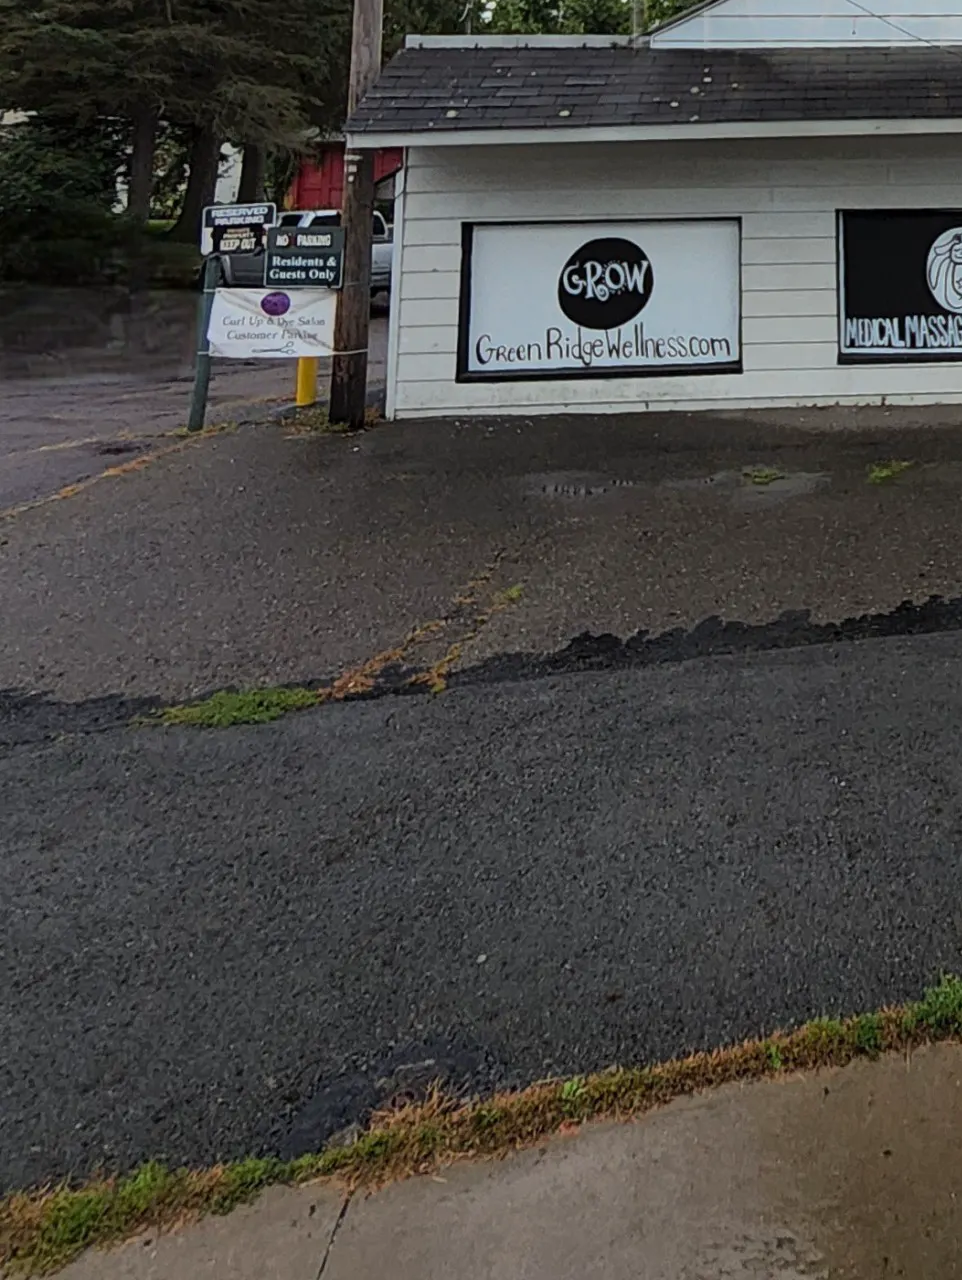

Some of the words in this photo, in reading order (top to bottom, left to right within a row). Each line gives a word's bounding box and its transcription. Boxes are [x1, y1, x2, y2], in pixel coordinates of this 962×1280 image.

[211, 206, 269, 218] RESERVED
[275, 234, 289, 246] NO
[296, 234, 331, 247] PARKING
[272, 255, 324, 267] Residents
[326, 256, 337, 267] &
[269, 268, 306, 279] Guests
[308, 268, 336, 282] Only
[562, 260, 649, 301] GROW
[222, 315, 245, 326] Curl
[248, 316, 263, 327] Up
[298, 316, 326, 326] Salon
[226, 329, 278, 340] Customer
[845, 317, 905, 348] MEDICAL
